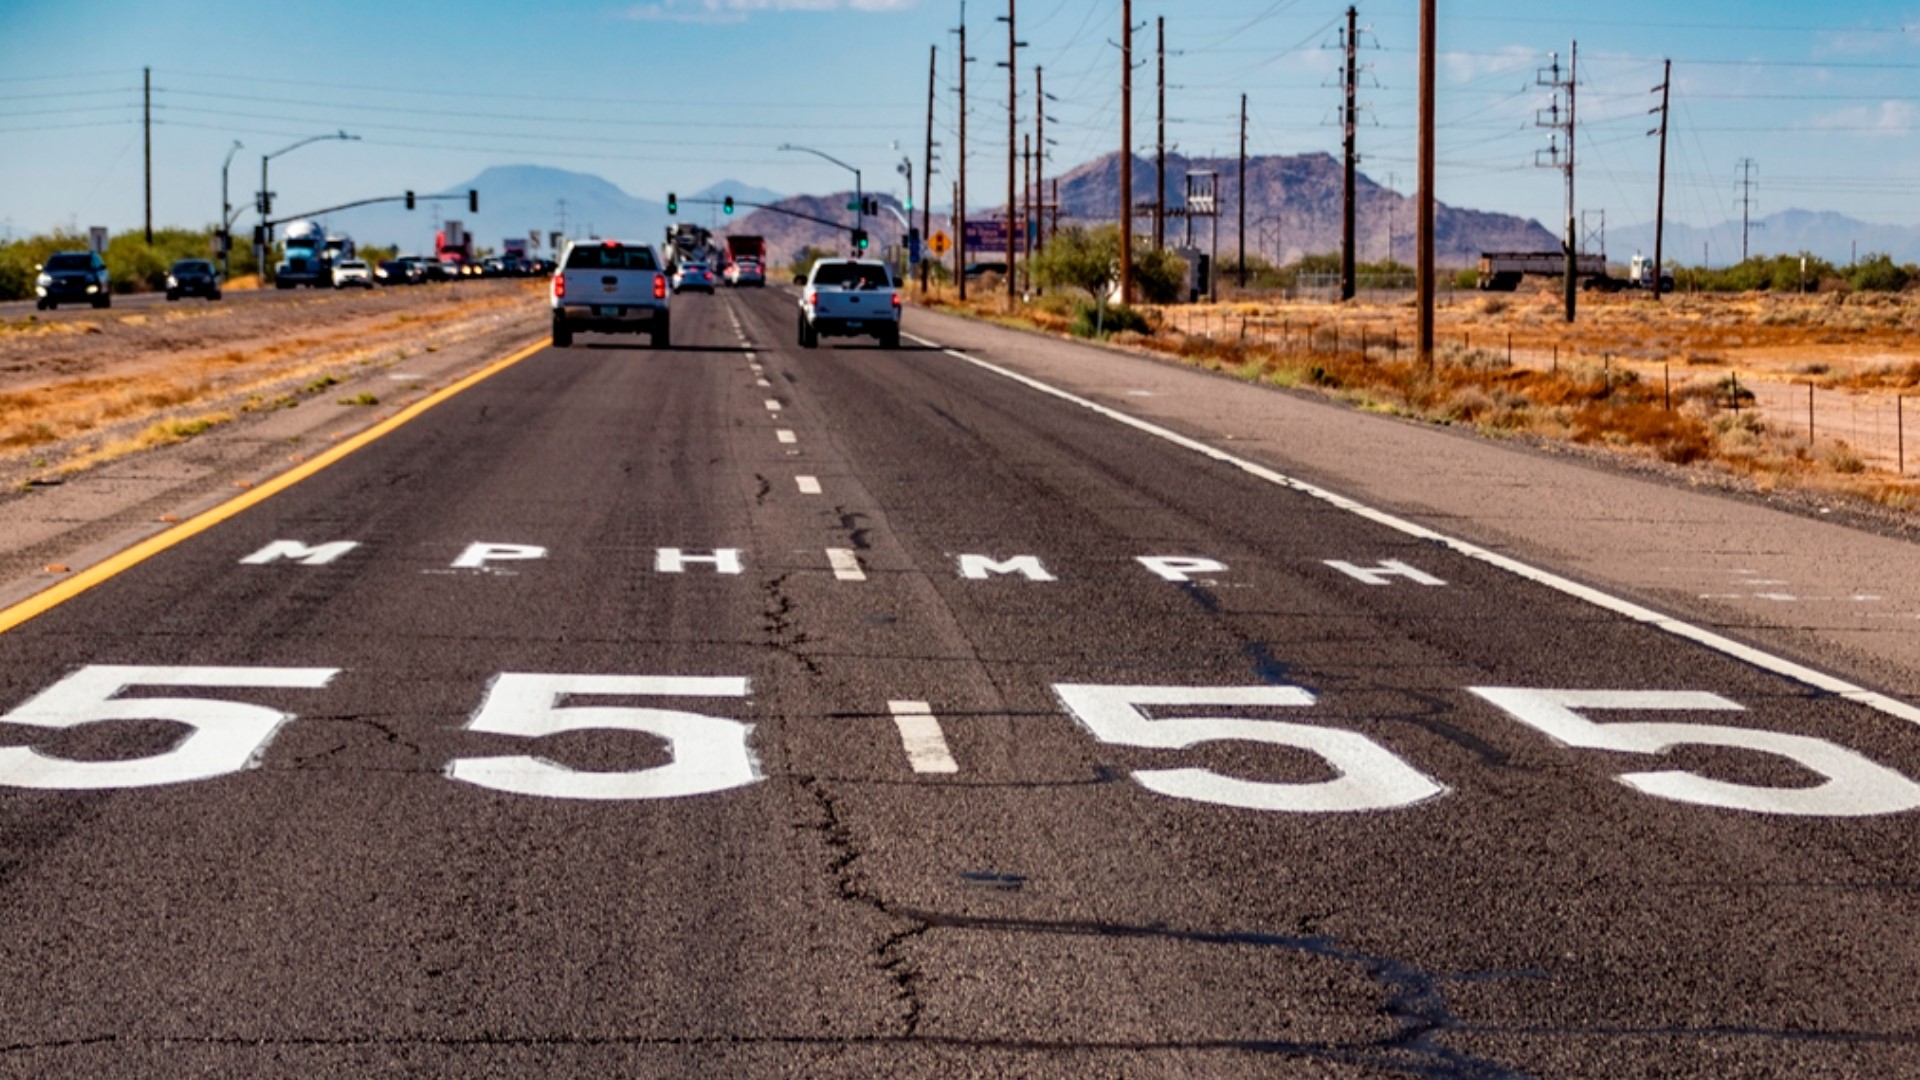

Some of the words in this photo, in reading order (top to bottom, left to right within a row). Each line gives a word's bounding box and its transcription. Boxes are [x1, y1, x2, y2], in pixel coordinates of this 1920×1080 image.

[239, 540, 746, 574] MPH
[957, 553, 1447, 586] MPH
[0, 664, 767, 800] 55
[1053, 682, 1920, 816] 55
